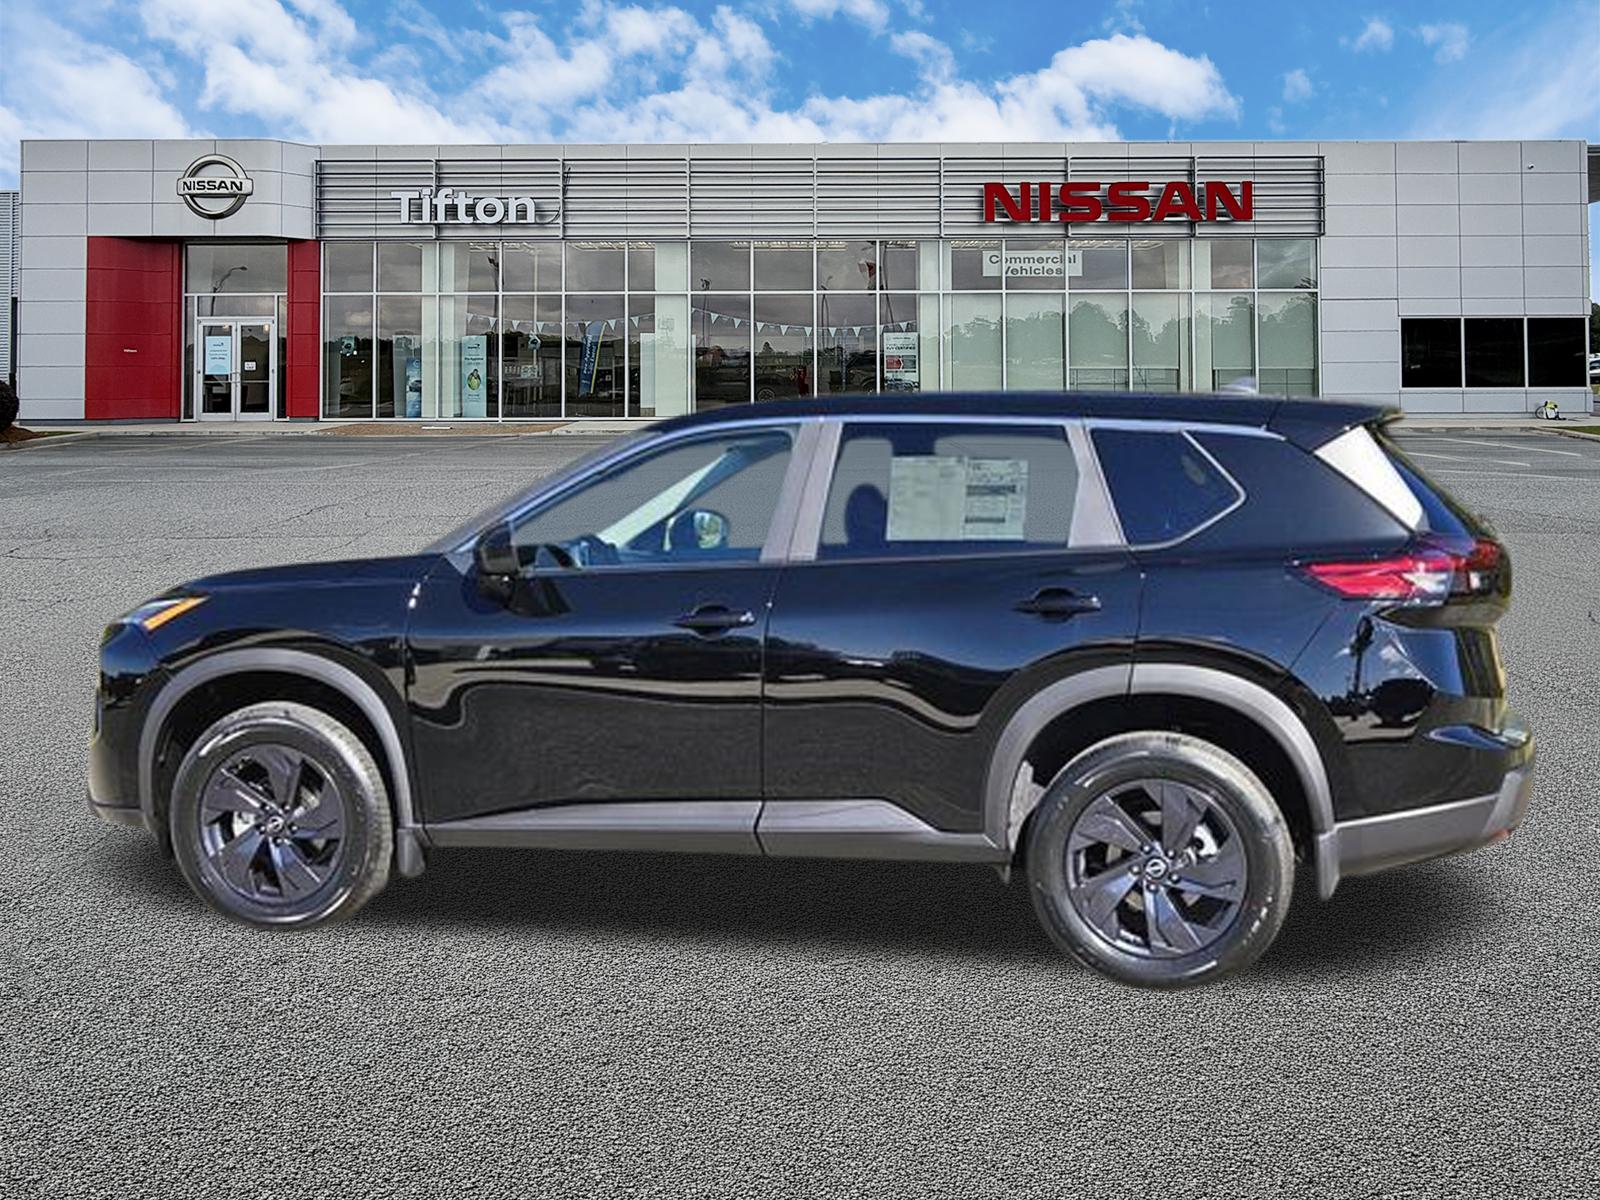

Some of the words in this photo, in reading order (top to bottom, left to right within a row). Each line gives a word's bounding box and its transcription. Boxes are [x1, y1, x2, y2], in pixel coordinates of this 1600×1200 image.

[182, 180, 243, 191] NISSAN
[391, 188, 536, 224] Tifton
[983, 181, 1253, 222] NISSAN
[1004, 265, 1063, 275] Vehicles
